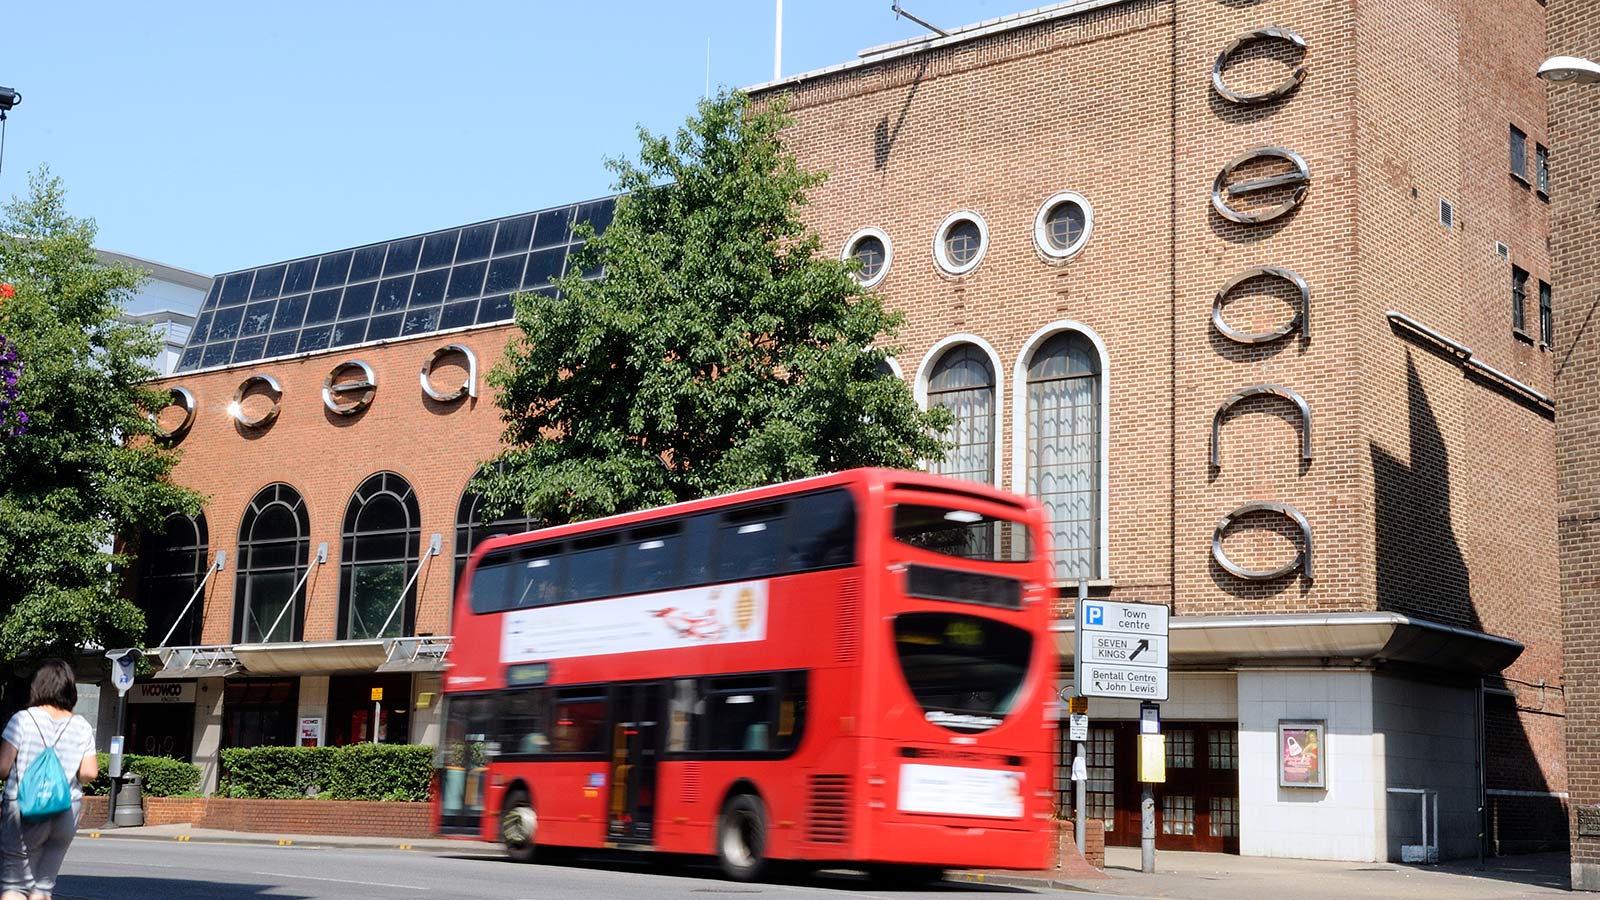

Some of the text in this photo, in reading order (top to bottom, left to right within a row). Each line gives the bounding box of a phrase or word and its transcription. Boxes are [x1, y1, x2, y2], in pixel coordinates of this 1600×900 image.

[1212, 26, 1313, 580] ceana
[1089, 607, 1102, 624] P
[1122, 608, 1147, 619] Town
[1118, 620, 1150, 630] centre
[1097, 638, 1128, 648] SEVEN
[1098, 649, 1126, 659] KINGS
[1093, 670, 1157, 682] Bentall Centre
[141, 683, 182, 697] WOOWOO
[1105, 682, 1155, 693] John Lewis
